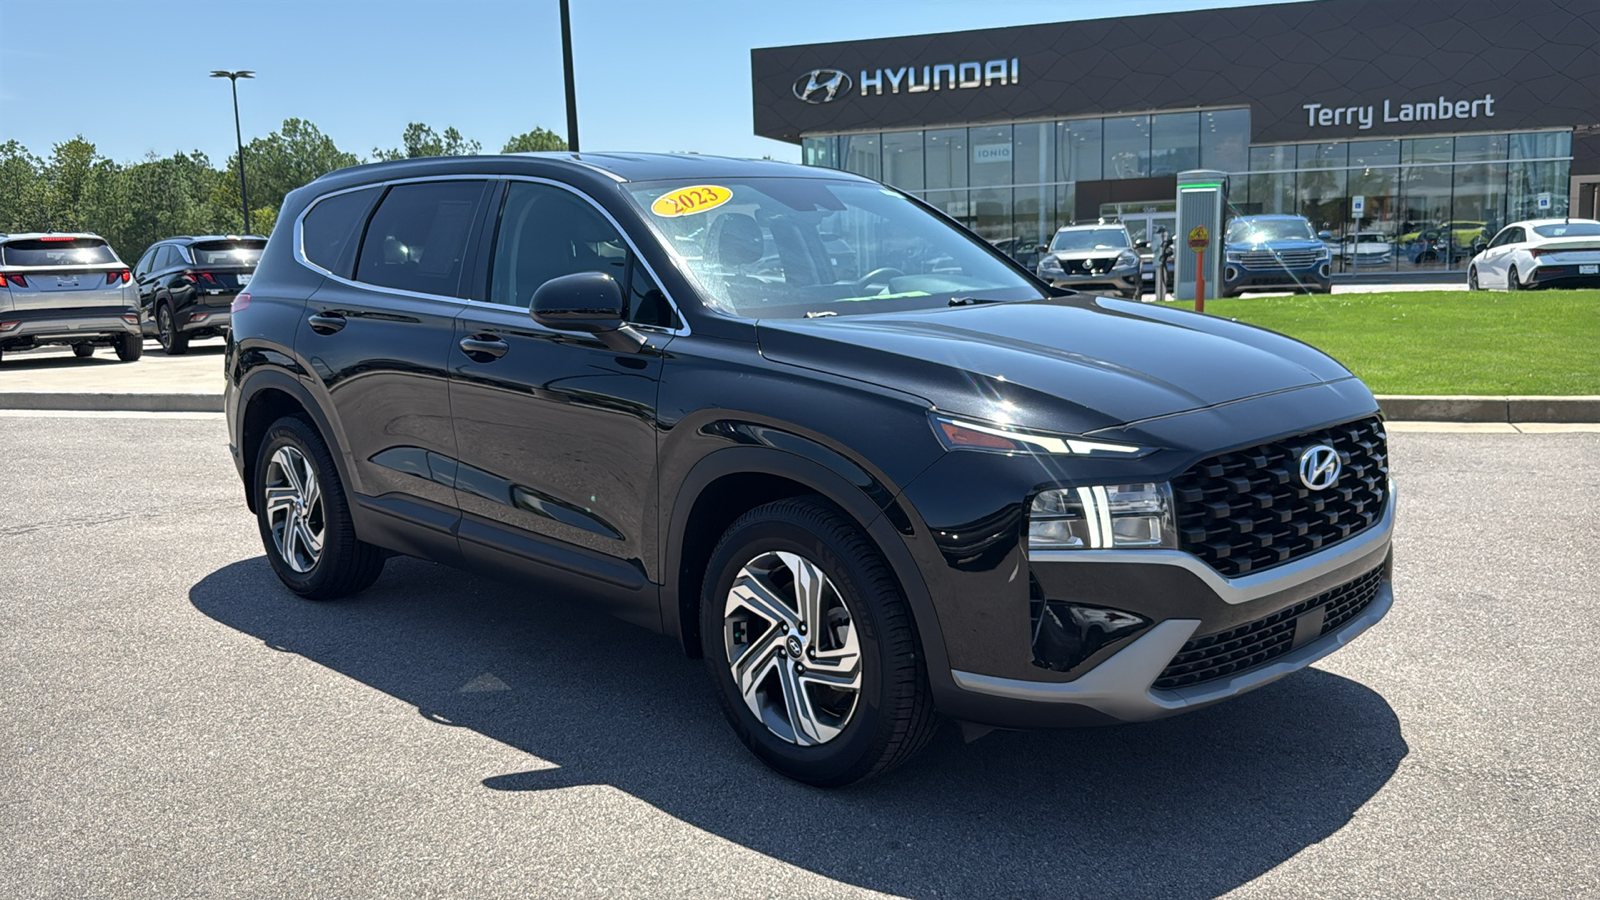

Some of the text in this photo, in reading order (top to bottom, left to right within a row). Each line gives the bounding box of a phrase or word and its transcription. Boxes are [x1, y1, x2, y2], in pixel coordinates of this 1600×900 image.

[860, 58, 1018, 96] HYUNDAI
[1303, 94, 1495, 129] Terry Lambert
[666, 187, 718, 213] 2023
